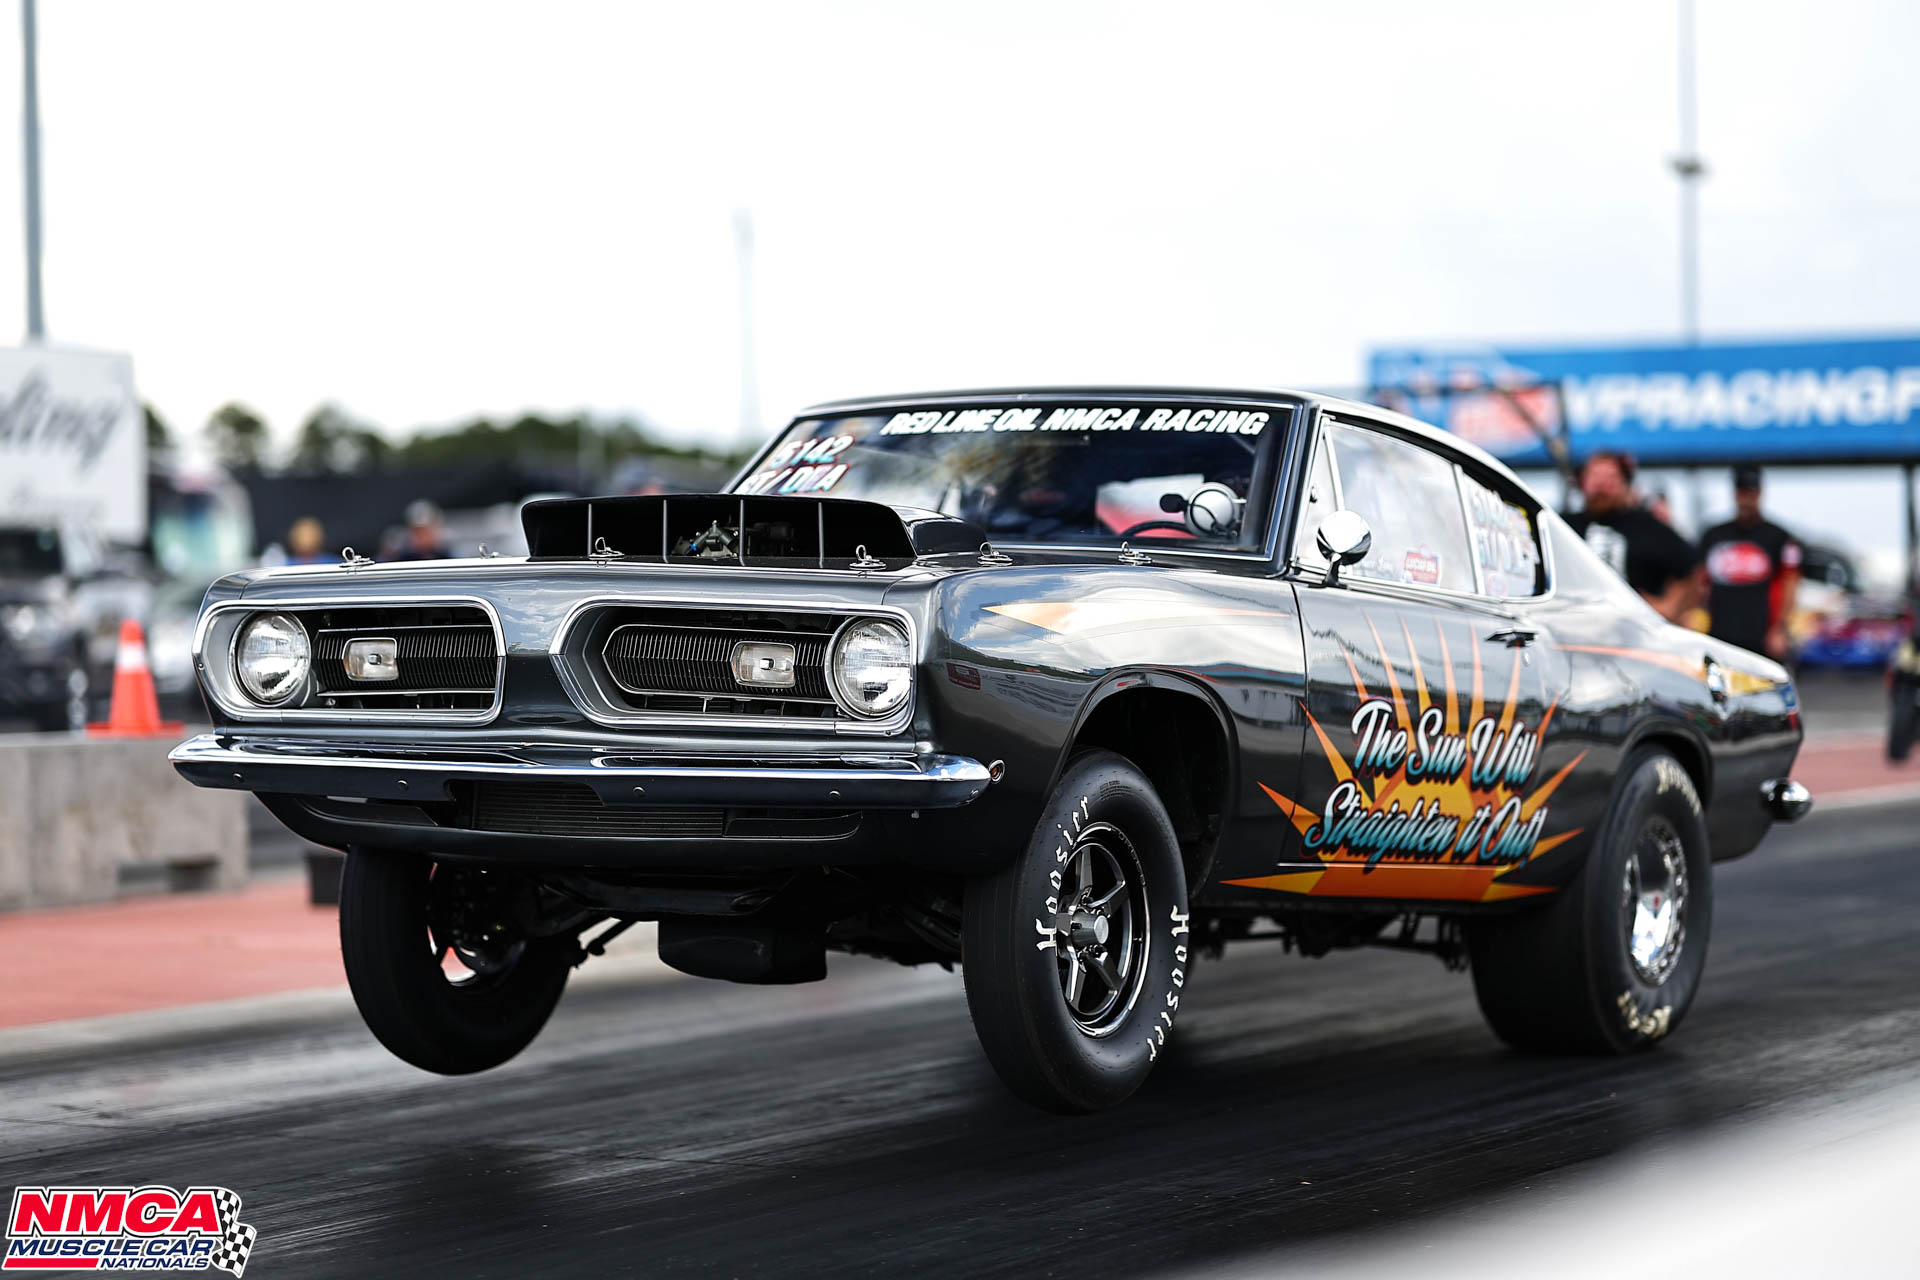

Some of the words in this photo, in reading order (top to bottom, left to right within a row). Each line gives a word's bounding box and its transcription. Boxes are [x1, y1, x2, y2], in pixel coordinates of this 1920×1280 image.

[1040, 408, 1140, 431] NMCA
[1140, 408, 1270, 436] RACING
[1351, 700, 1408, 769] The
[1407, 708, 1467, 776] Sun
[1471, 717, 1538, 784] Will
[1305, 782, 1459, 868] Straighten
[1454, 804, 1492, 854] it
